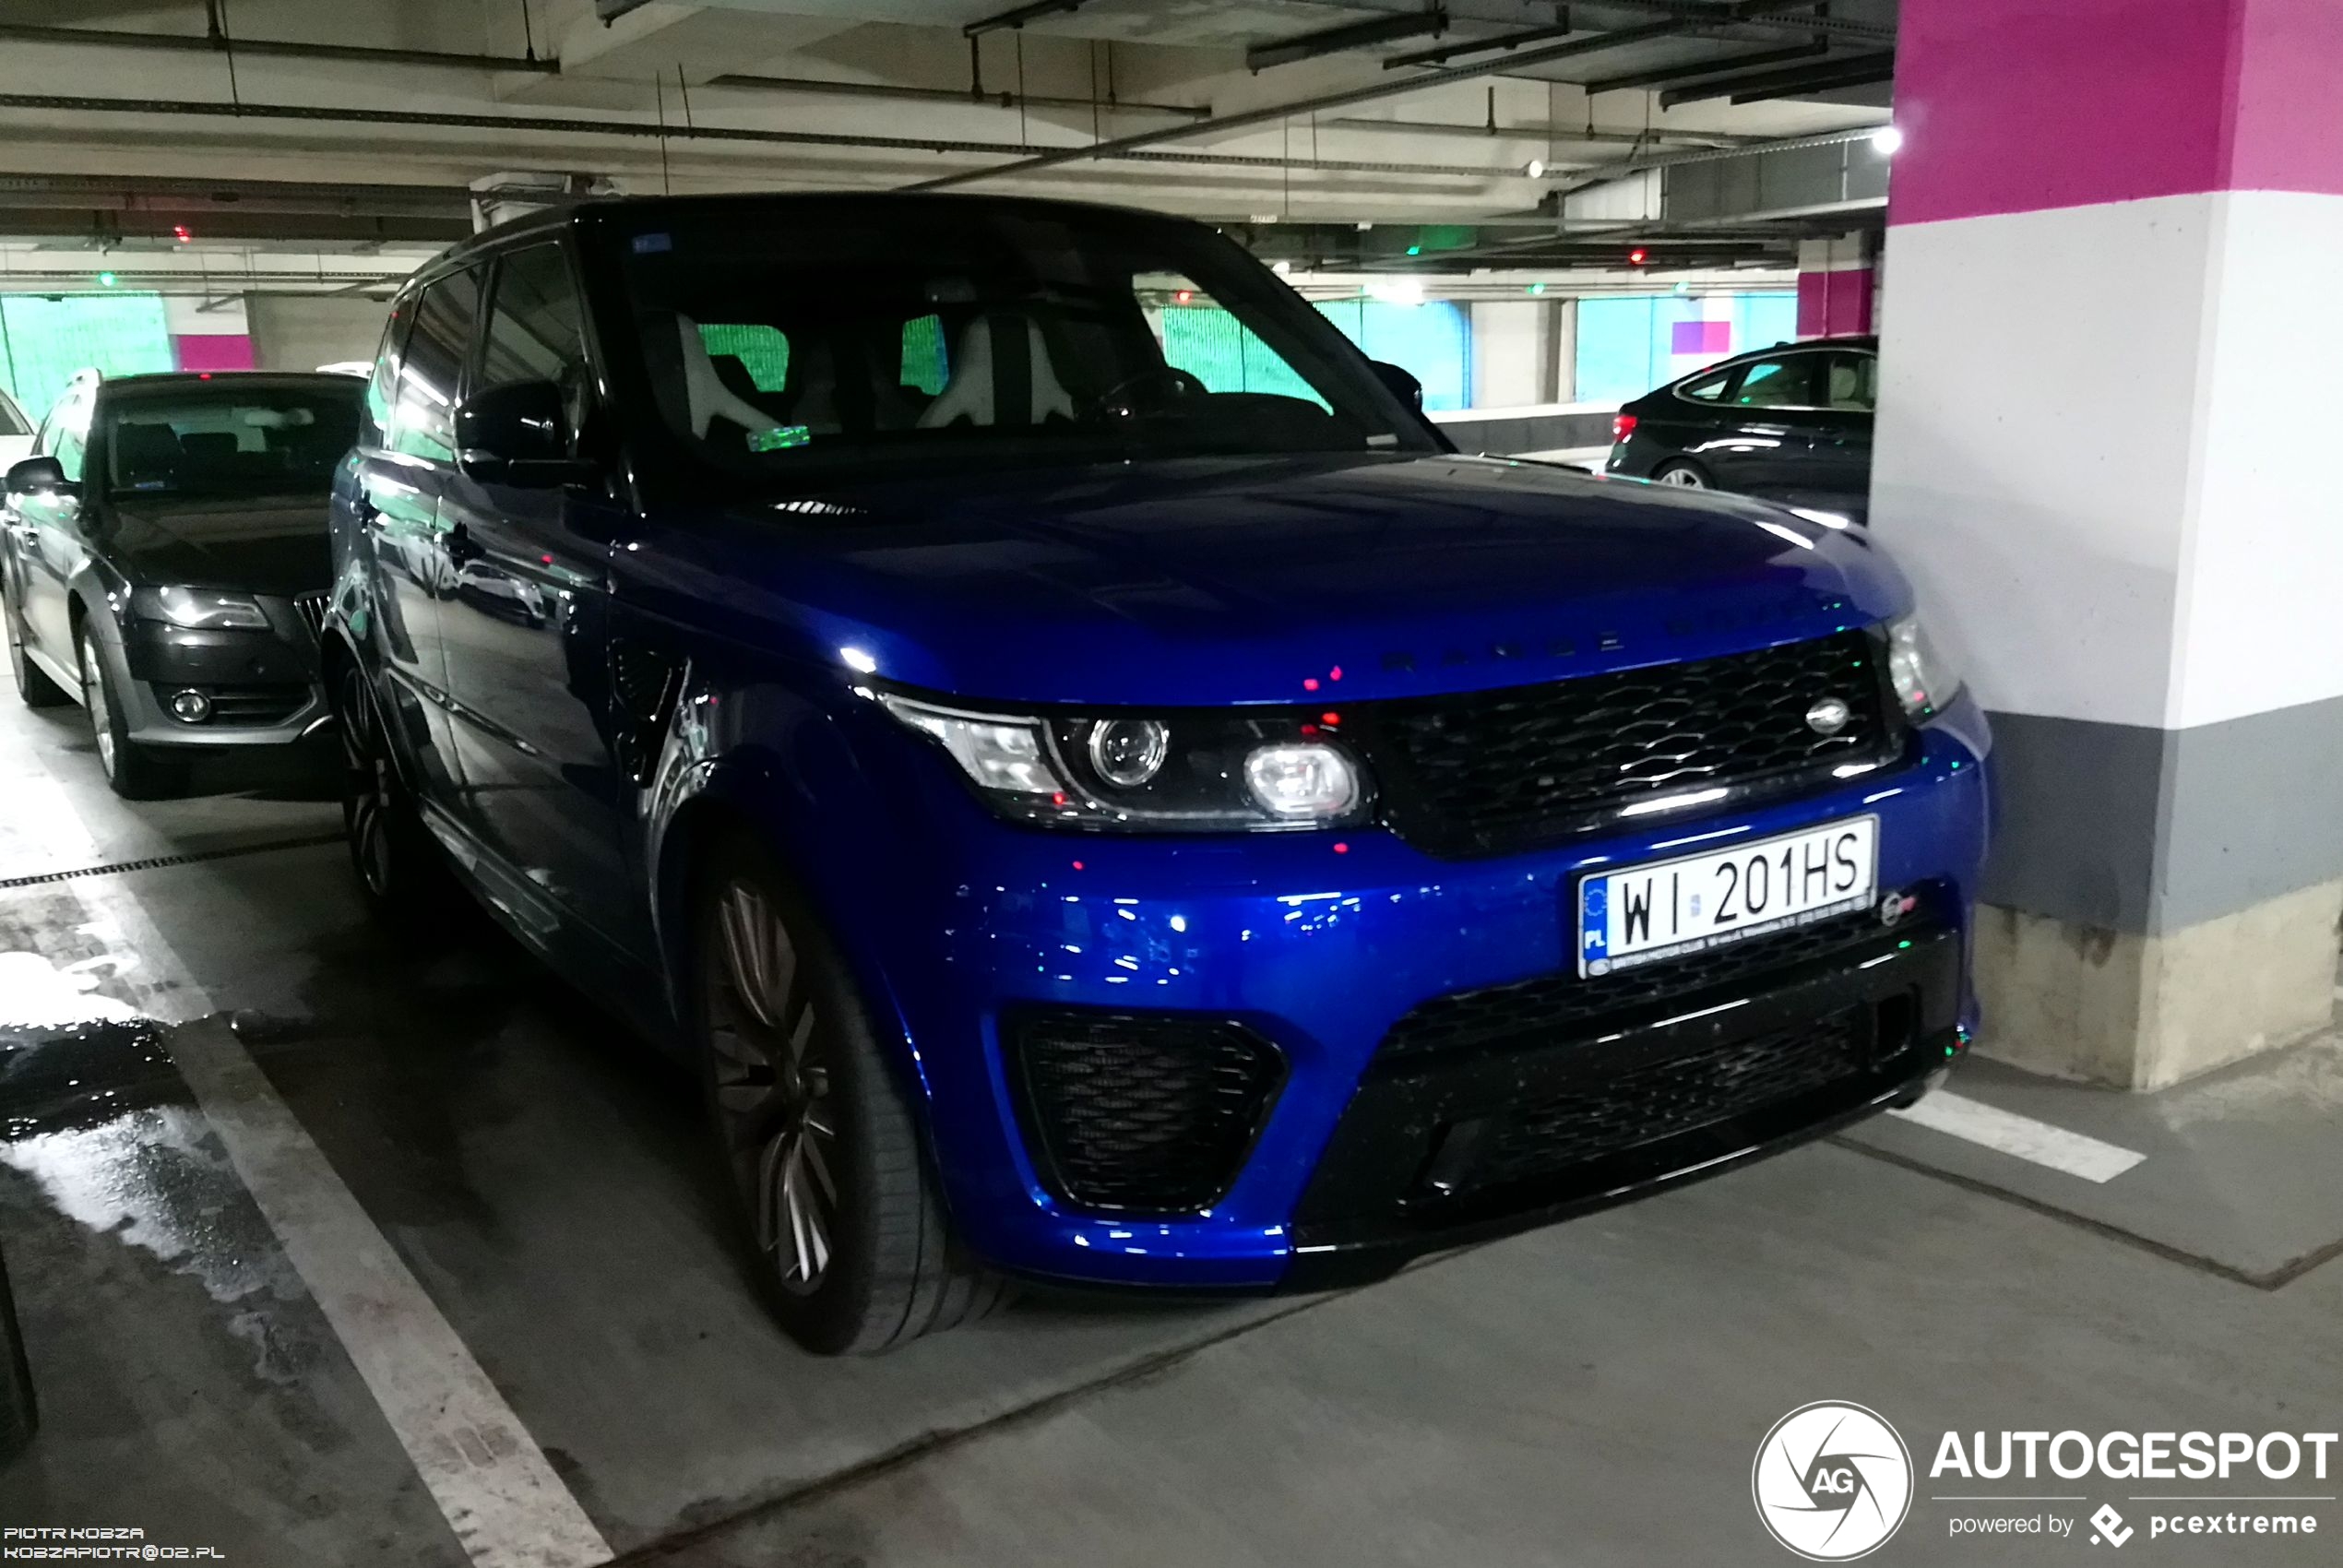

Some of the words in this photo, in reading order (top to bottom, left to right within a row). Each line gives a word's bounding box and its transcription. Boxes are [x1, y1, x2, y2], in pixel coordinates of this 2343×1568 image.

[1623, 872, 1679, 945] WI
[1714, 832, 1858, 924] 201HS
[1585, 929, 1606, 950] PL
